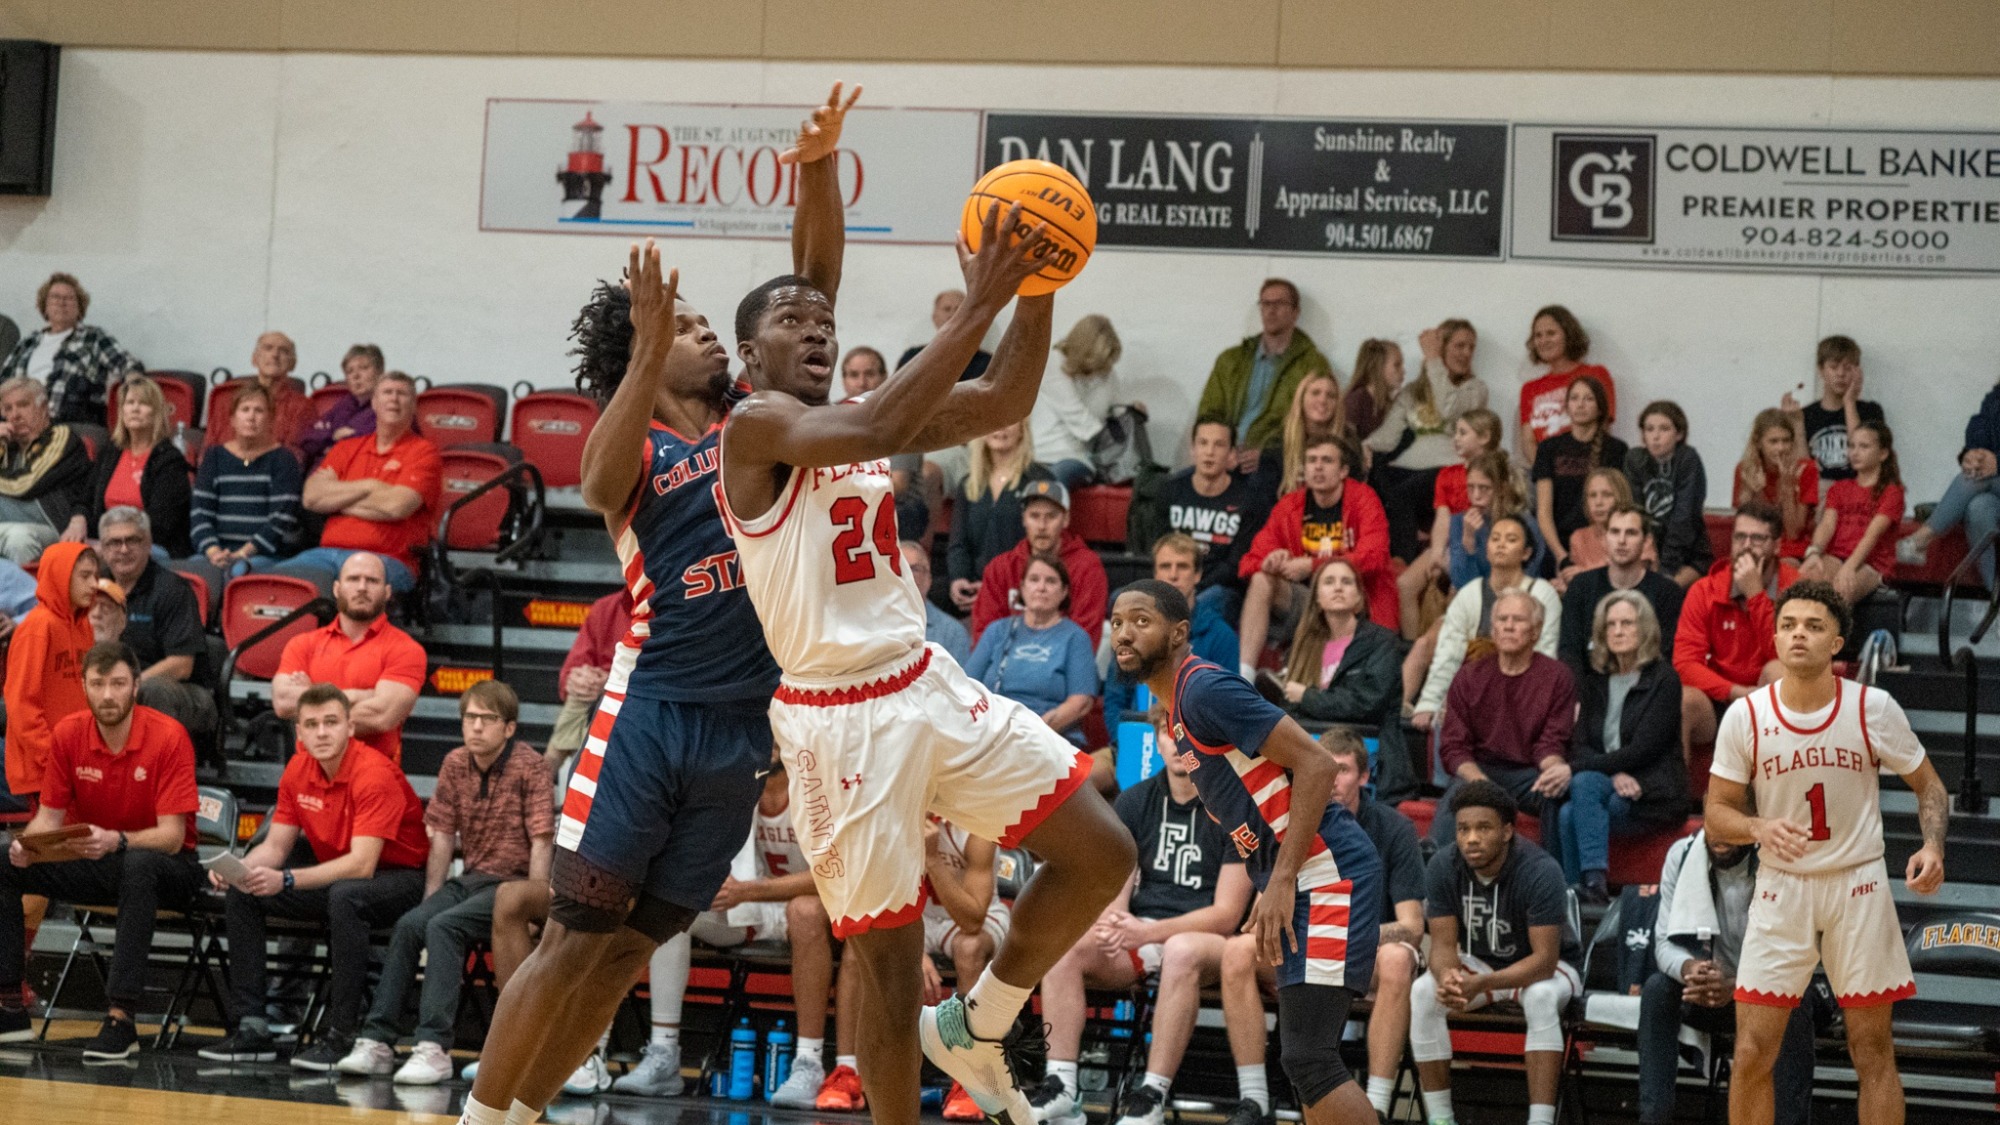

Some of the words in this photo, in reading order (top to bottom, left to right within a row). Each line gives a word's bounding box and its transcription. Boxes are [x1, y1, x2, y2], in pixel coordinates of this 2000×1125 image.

[1314, 126, 1395, 153] Sunshine
[1400, 128, 1457, 161] Realty
[1665, 143, 1866, 176] COLDWELL
[1106, 138, 1234, 194] LANG
[1374, 159, 1391, 182] &
[1038, 187, 1086, 222] EVO
[1115, 203, 1164, 226] REAL
[1165, 205, 1232, 229] ESTATE
[1275, 185, 1359, 218] Appraisal
[1364, 187, 1443, 218] Services,
[1448, 189, 1490, 215] LLC
[1682, 195, 1815, 219] PREMIER
[1325, 223, 1435, 251] 904.501.6867
[1742, 226, 1949, 250] 904-824-5000
[653, 446, 719, 496] COLU
[1169, 504, 1241, 536] DAWGS
[829, 492, 902, 586] 24
[1763, 747, 1863, 780] FLAGLER
[797, 749, 846, 879] SAINTS
[1805, 782, 1831, 842] 1
[1153, 822, 1202, 890] FC
[1850, 881, 1879, 898] PBC
[1921, 923, 2000, 952] FLAGLE
